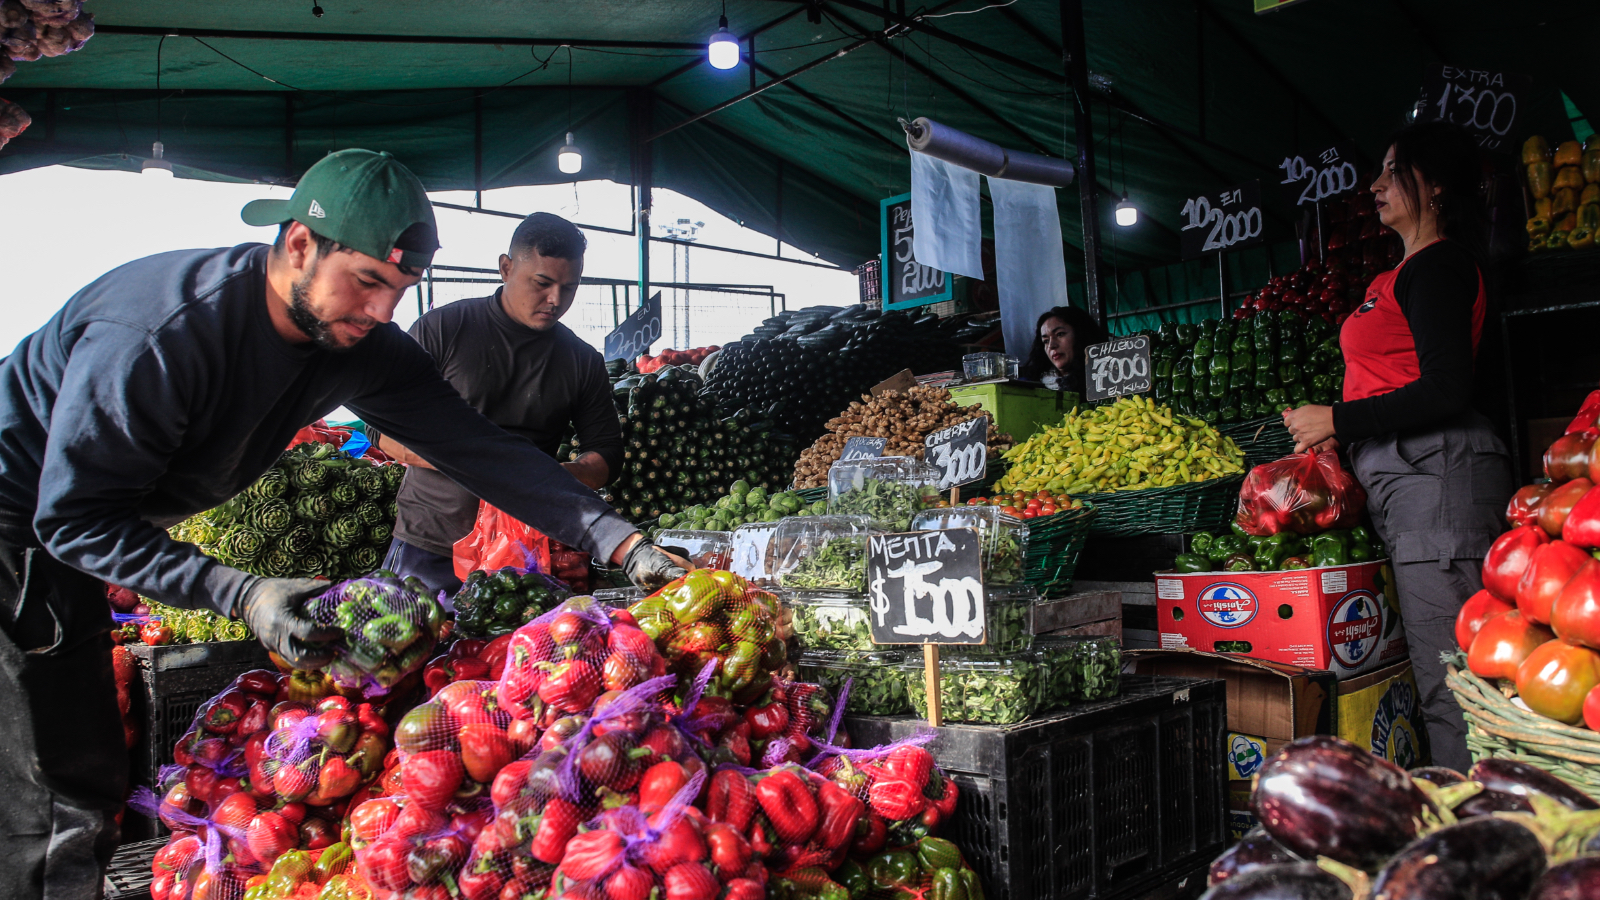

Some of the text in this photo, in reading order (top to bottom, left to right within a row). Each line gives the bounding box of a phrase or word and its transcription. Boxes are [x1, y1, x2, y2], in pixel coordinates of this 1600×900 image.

[1442, 65, 1504, 87] EXTRA
[1433, 82, 1517, 135] 1300
[1279, 155, 1307, 184] 10
[1296, 161, 1358, 206] 2000
[1180, 196, 1211, 231] 10
[1201, 207, 1263, 252] 2000
[1088, 338, 1146, 359] CHILENO
[1091, 353, 1148, 393] 7000
[925, 418, 978, 448] CHERRY
[870, 558, 986, 639] $ 1500
